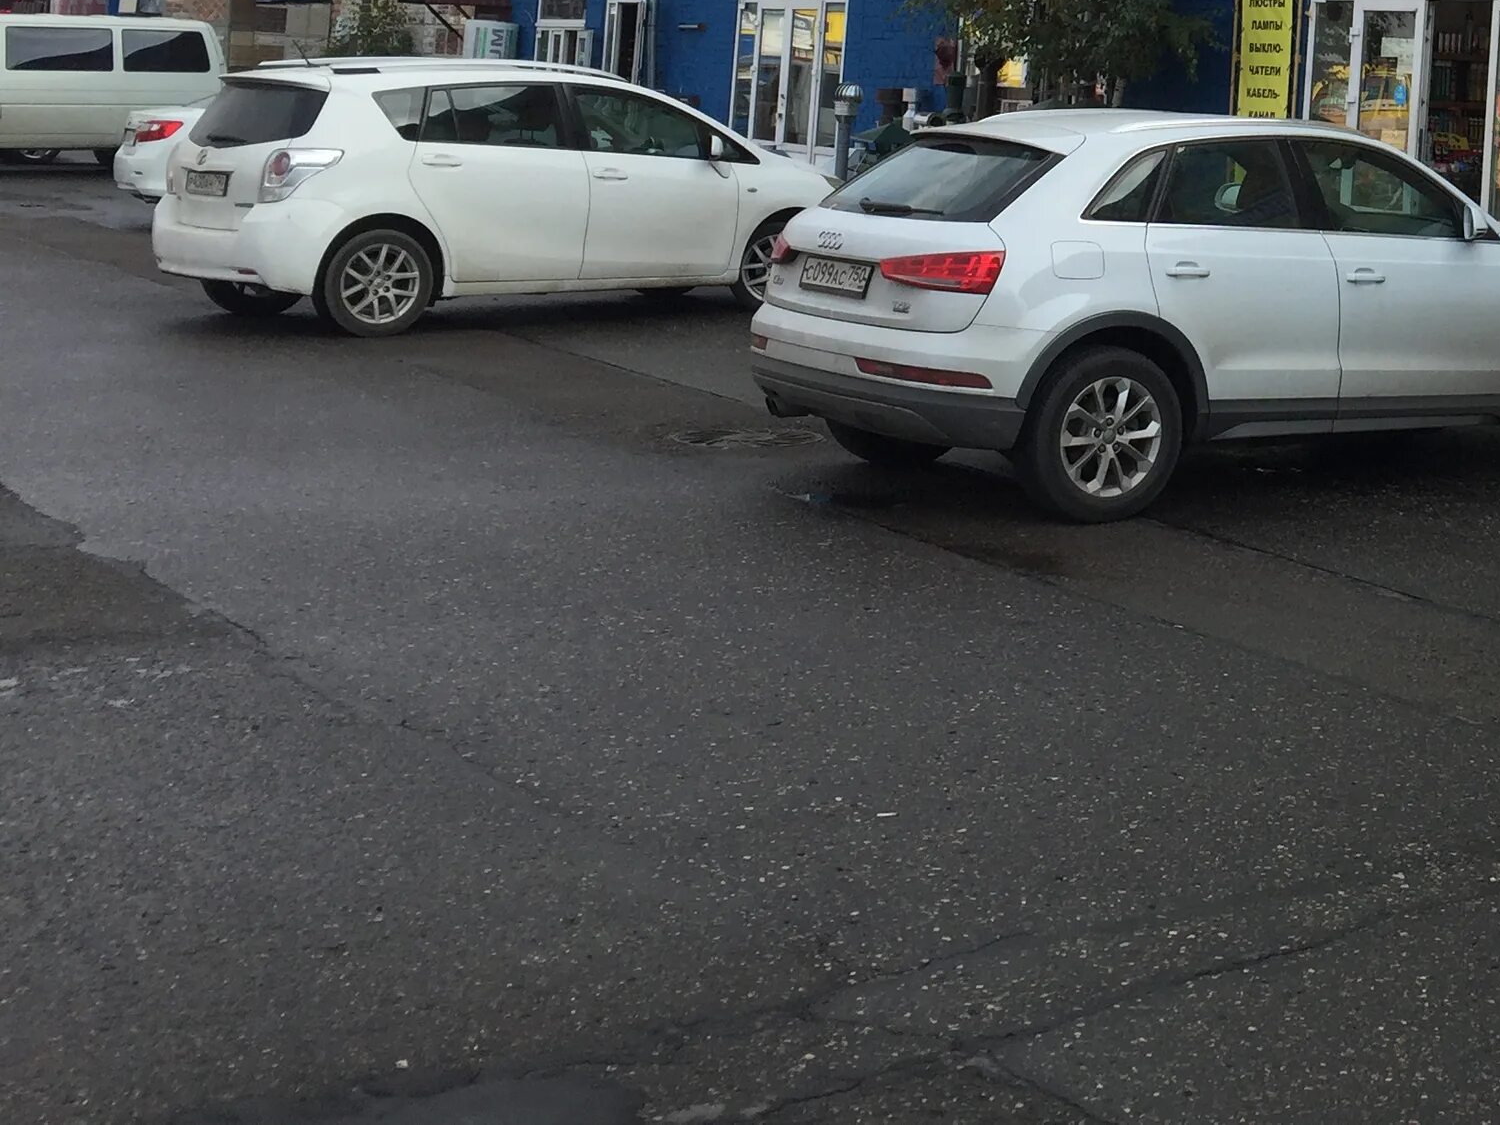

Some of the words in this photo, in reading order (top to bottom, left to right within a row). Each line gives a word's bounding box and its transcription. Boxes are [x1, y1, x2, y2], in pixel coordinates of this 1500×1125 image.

[1251, 20, 1283, 31] ЛАМПЫ
[1249, 42, 1284, 53] ВЫКЛЮ-
[1249, 65, 1281, 76] ЧАТЕЛИ
[1246, 88, 1281, 99] КАБЕЛЬ-
